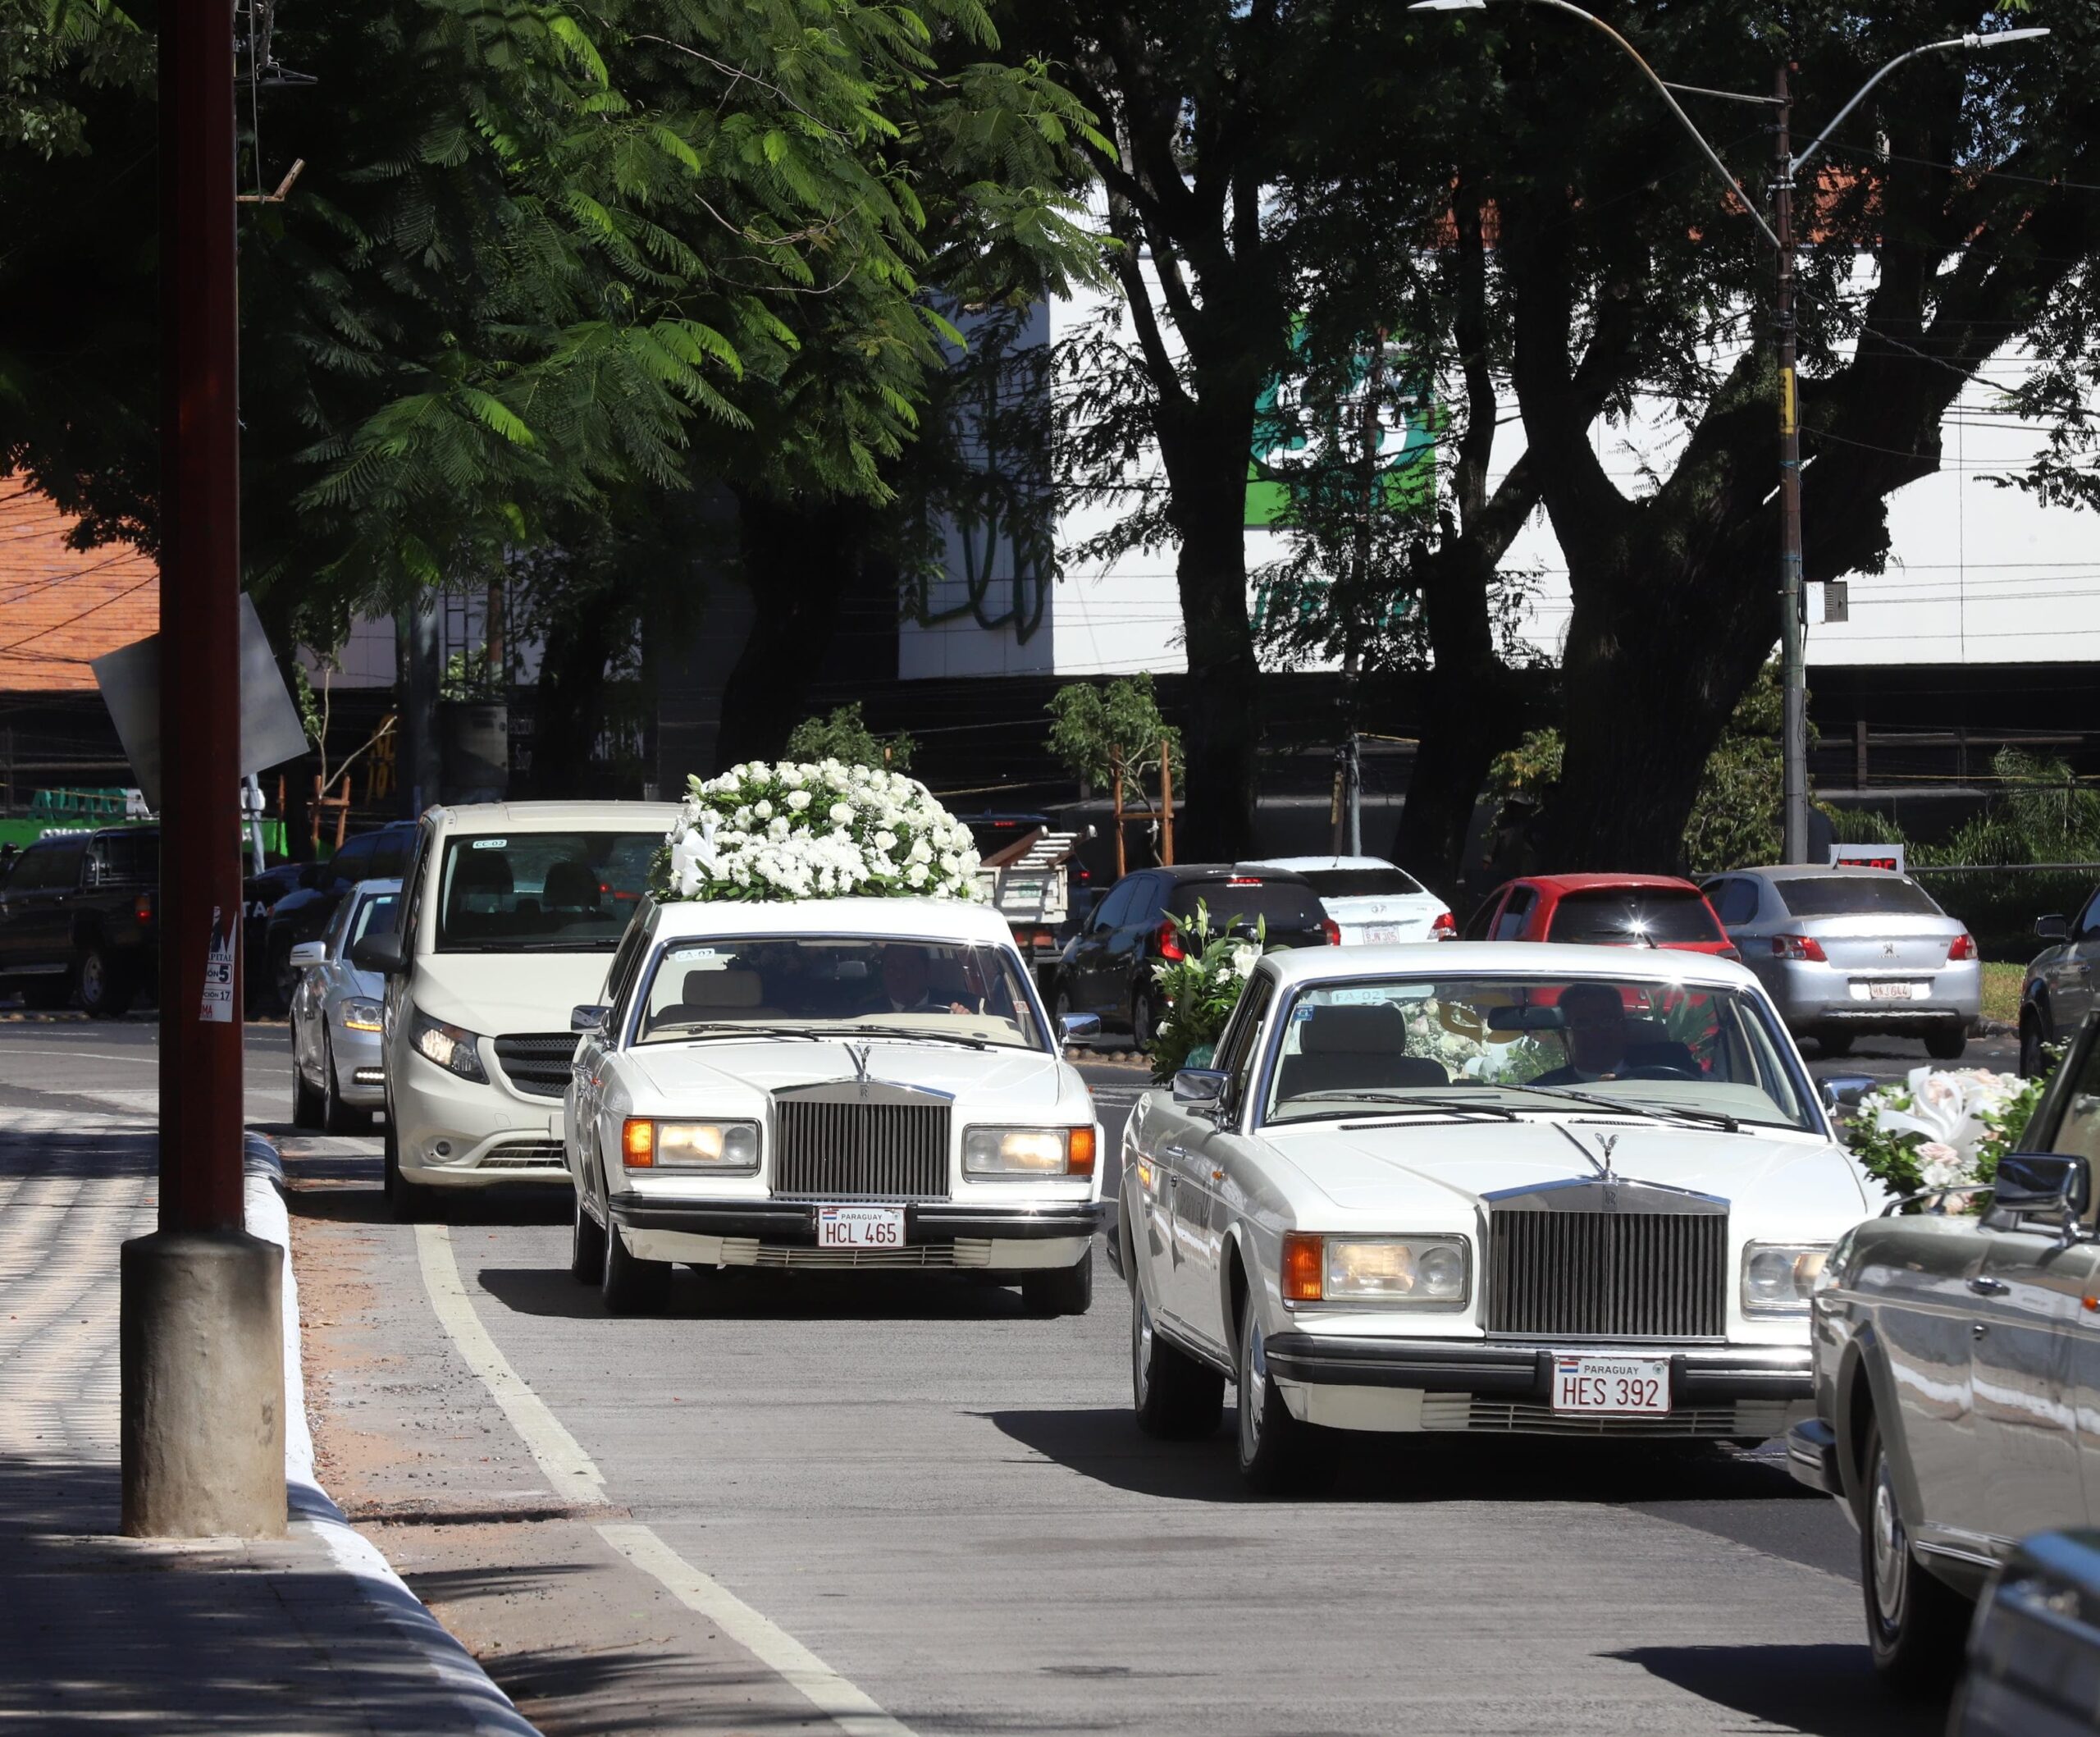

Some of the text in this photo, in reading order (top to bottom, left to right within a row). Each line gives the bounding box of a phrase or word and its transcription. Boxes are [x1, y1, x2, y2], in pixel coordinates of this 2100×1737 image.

[209, 953, 233, 962] PITAL
[218, 965, 229, 983] 5
[220, 990, 231, 1001] 17
[826, 1223, 897, 1243] HCL 465
[1584, 1364, 1640, 1375] PARAGUAY
[1563, 1377, 1659, 1407] HES 392
